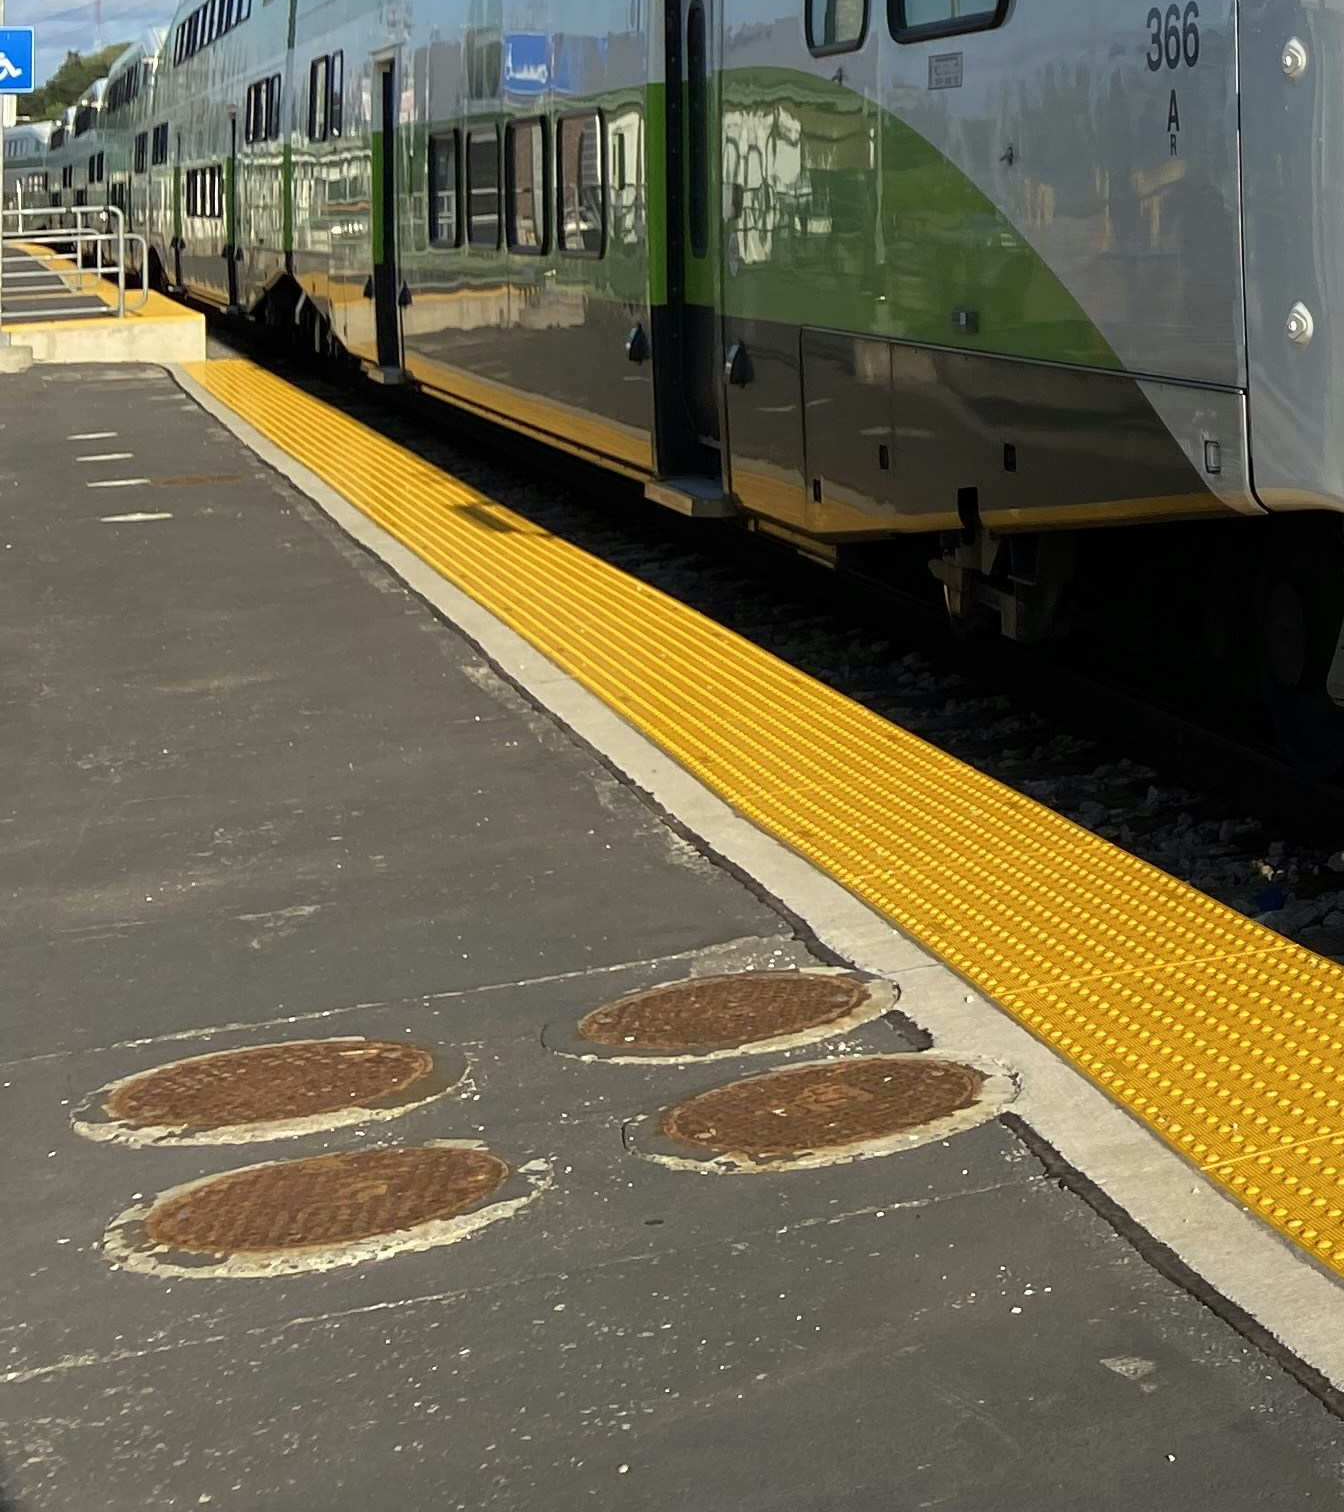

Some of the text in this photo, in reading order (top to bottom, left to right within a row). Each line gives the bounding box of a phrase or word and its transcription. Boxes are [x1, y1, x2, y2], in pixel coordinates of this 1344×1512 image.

[1146, 0, 1200, 72] 366
[1167, 88, 1180, 132] A
[1170, 134, 1178, 156] R
